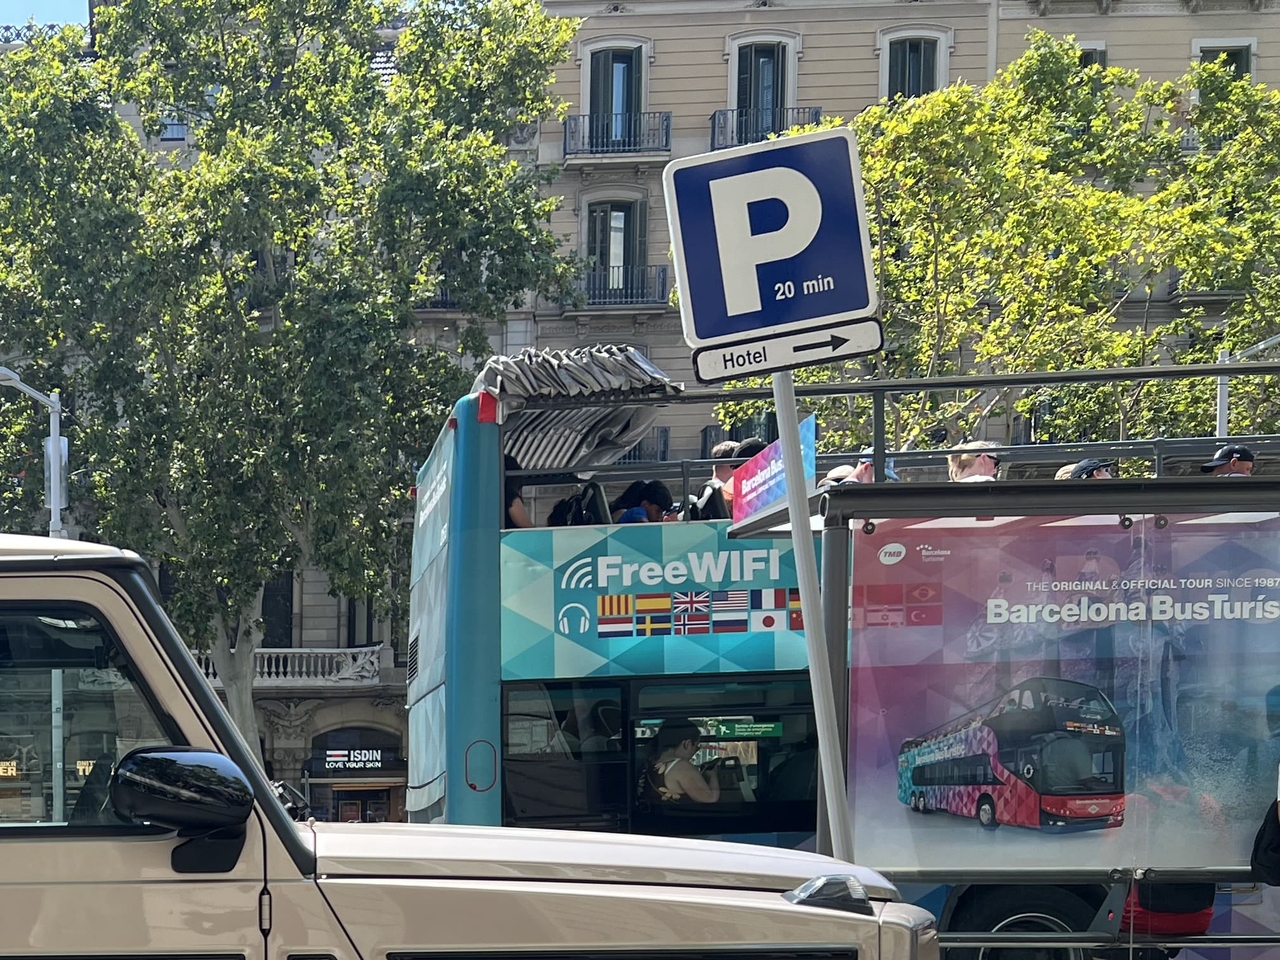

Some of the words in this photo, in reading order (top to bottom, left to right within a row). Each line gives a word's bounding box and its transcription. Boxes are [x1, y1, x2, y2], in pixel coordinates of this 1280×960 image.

[709, 166, 823, 317] P
[774, 281, 795, 301] 20
[802, 274, 835, 295] min
[723, 346, 768, 370] Hotel
[883, 550, 902, 558] TMB
[1026, 581, 1050, 592] THE
[1051, 580, 1109, 591] ORIGINAL
[1111, 580, 1119, 590] &
[1121, 579, 1177, 590] OFFICIAL
[1179, 578, 1213, 589] TOUR
[1215, 578, 1252, 588] SINCE
[1253, 577, 1280, 588] 1987
[986, 596, 1147, 624] Barcelona
[350, 749, 381, 761] ISDIN
[325, 761, 344, 769] LOVE
[345, 761, 365, 769] YOUR
[365, 761, 382, 769] SKIN
